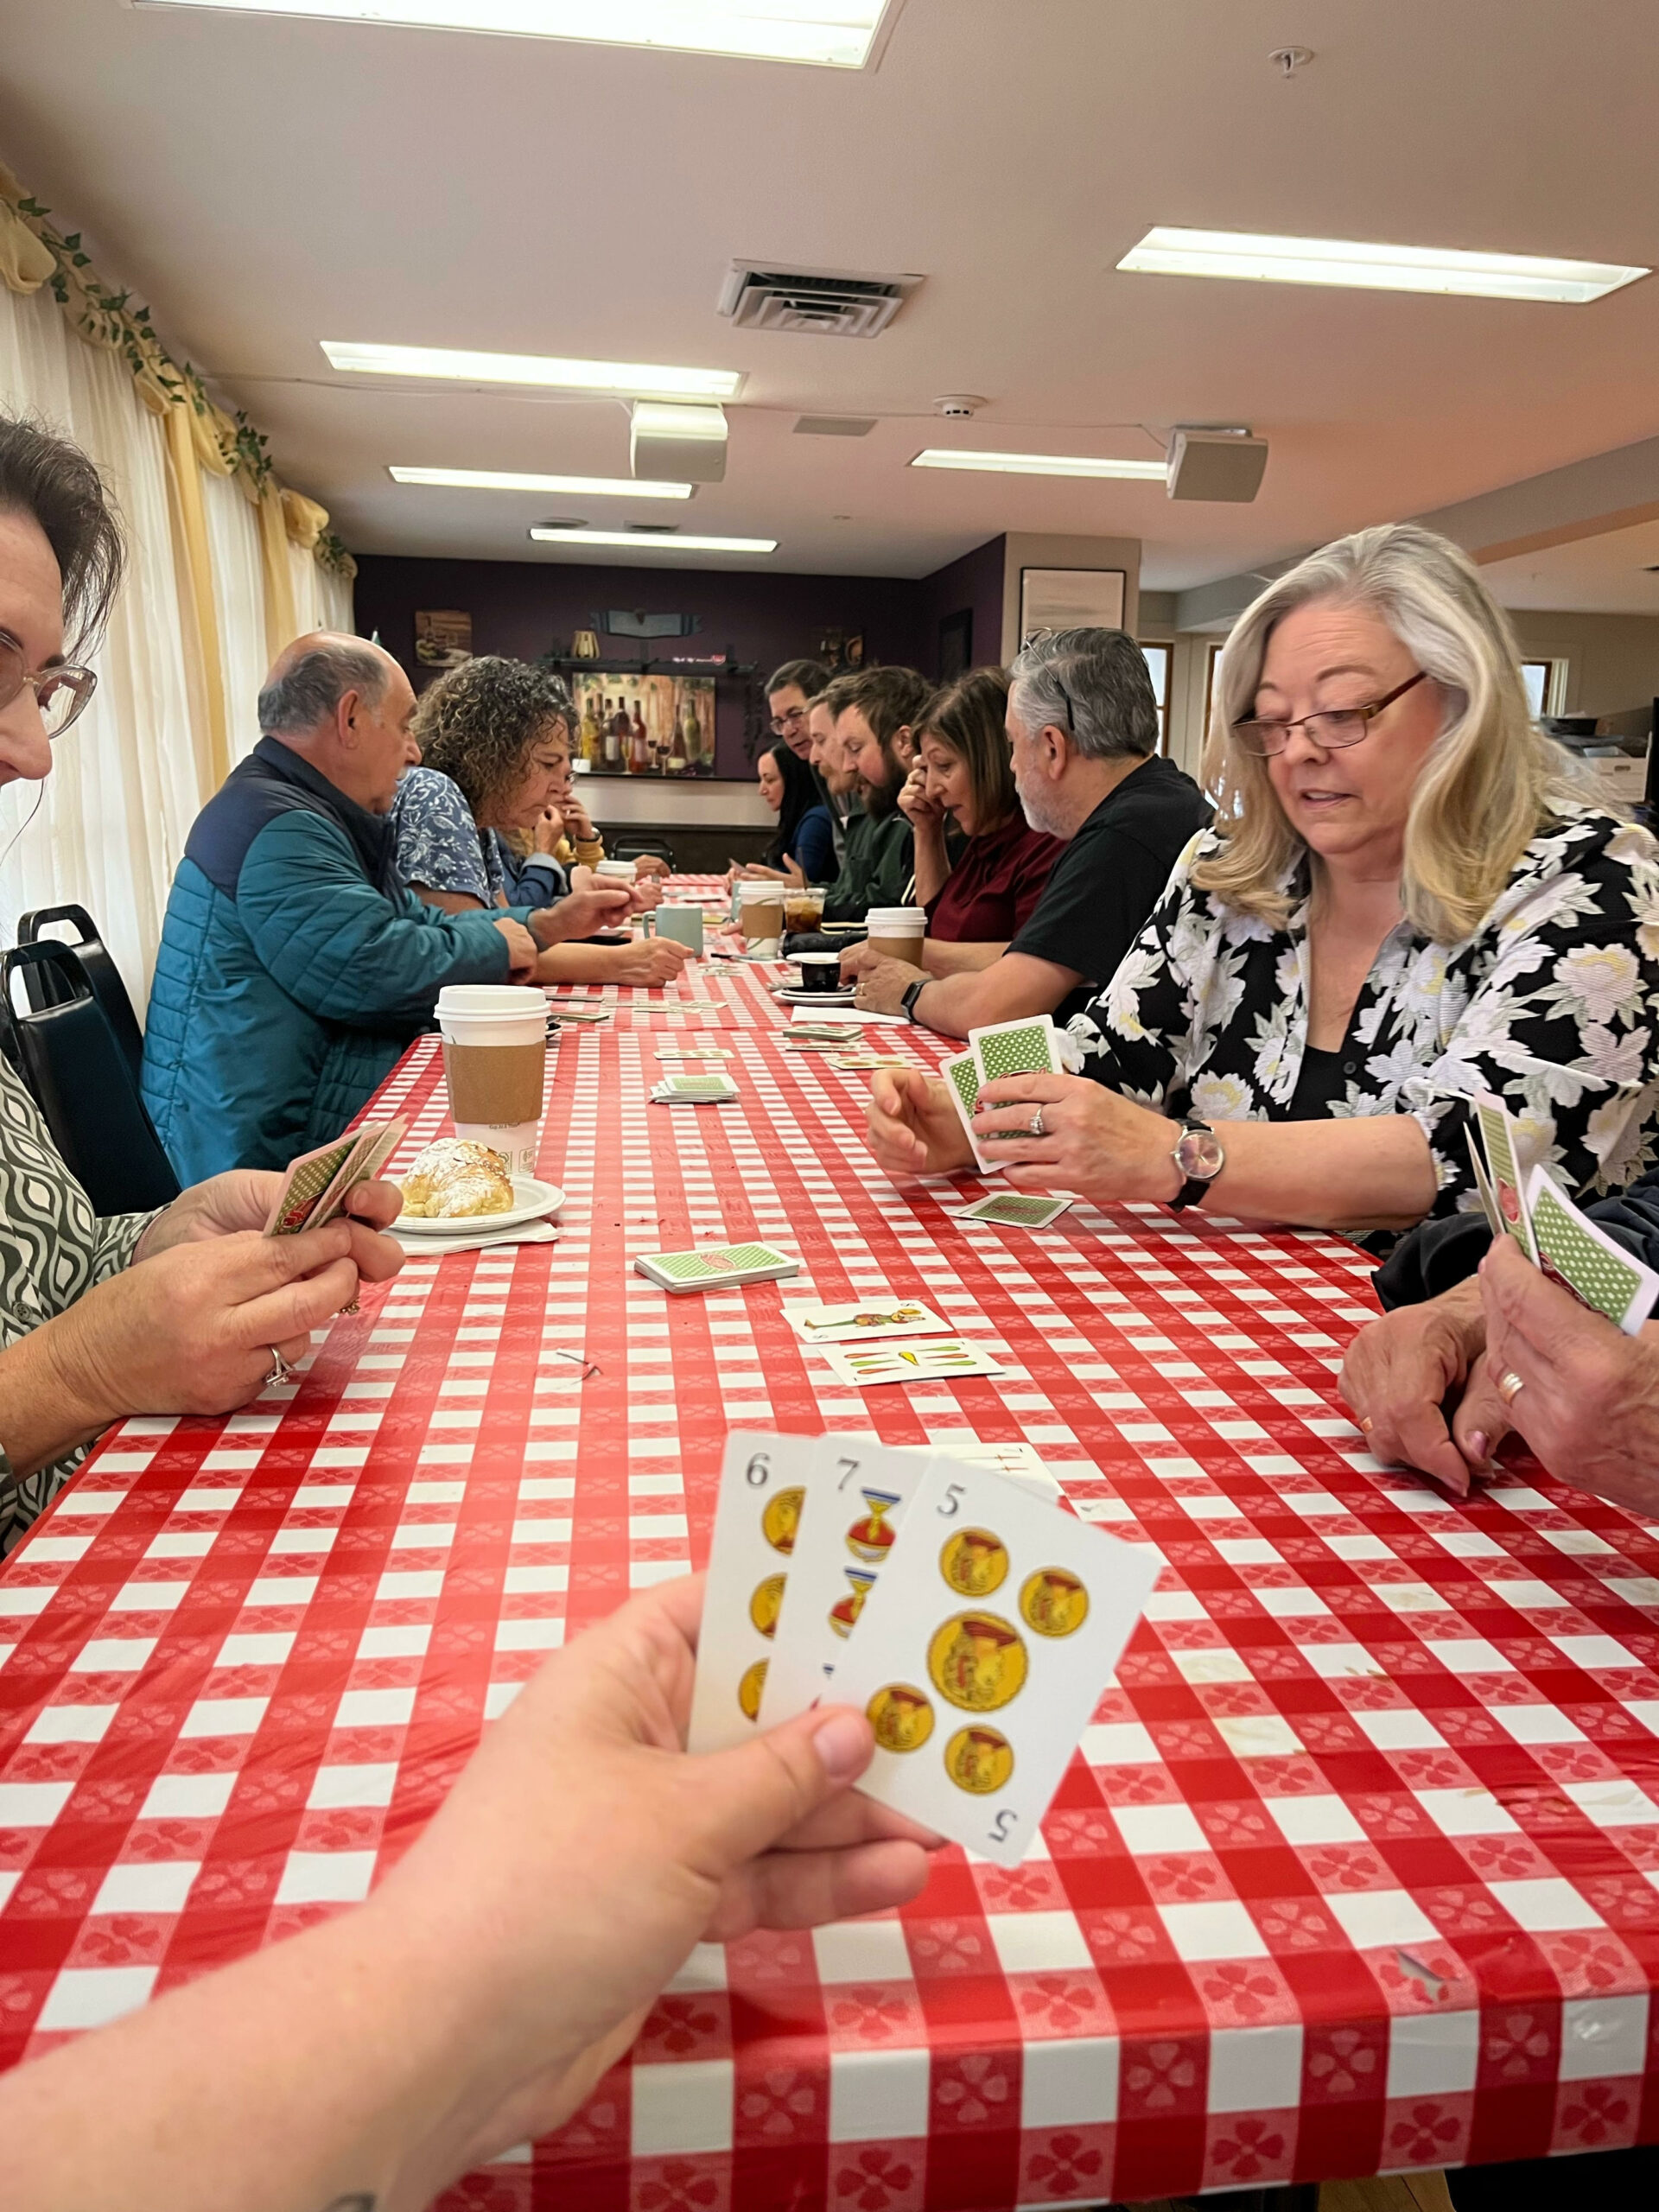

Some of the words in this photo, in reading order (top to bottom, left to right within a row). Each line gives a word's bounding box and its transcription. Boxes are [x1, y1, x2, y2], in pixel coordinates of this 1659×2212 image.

[746, 1452, 771, 1487] 6
[836, 1457, 860, 1492] 7
[936, 1483, 967, 1519] 5
[988, 1808, 1019, 1843] 5
